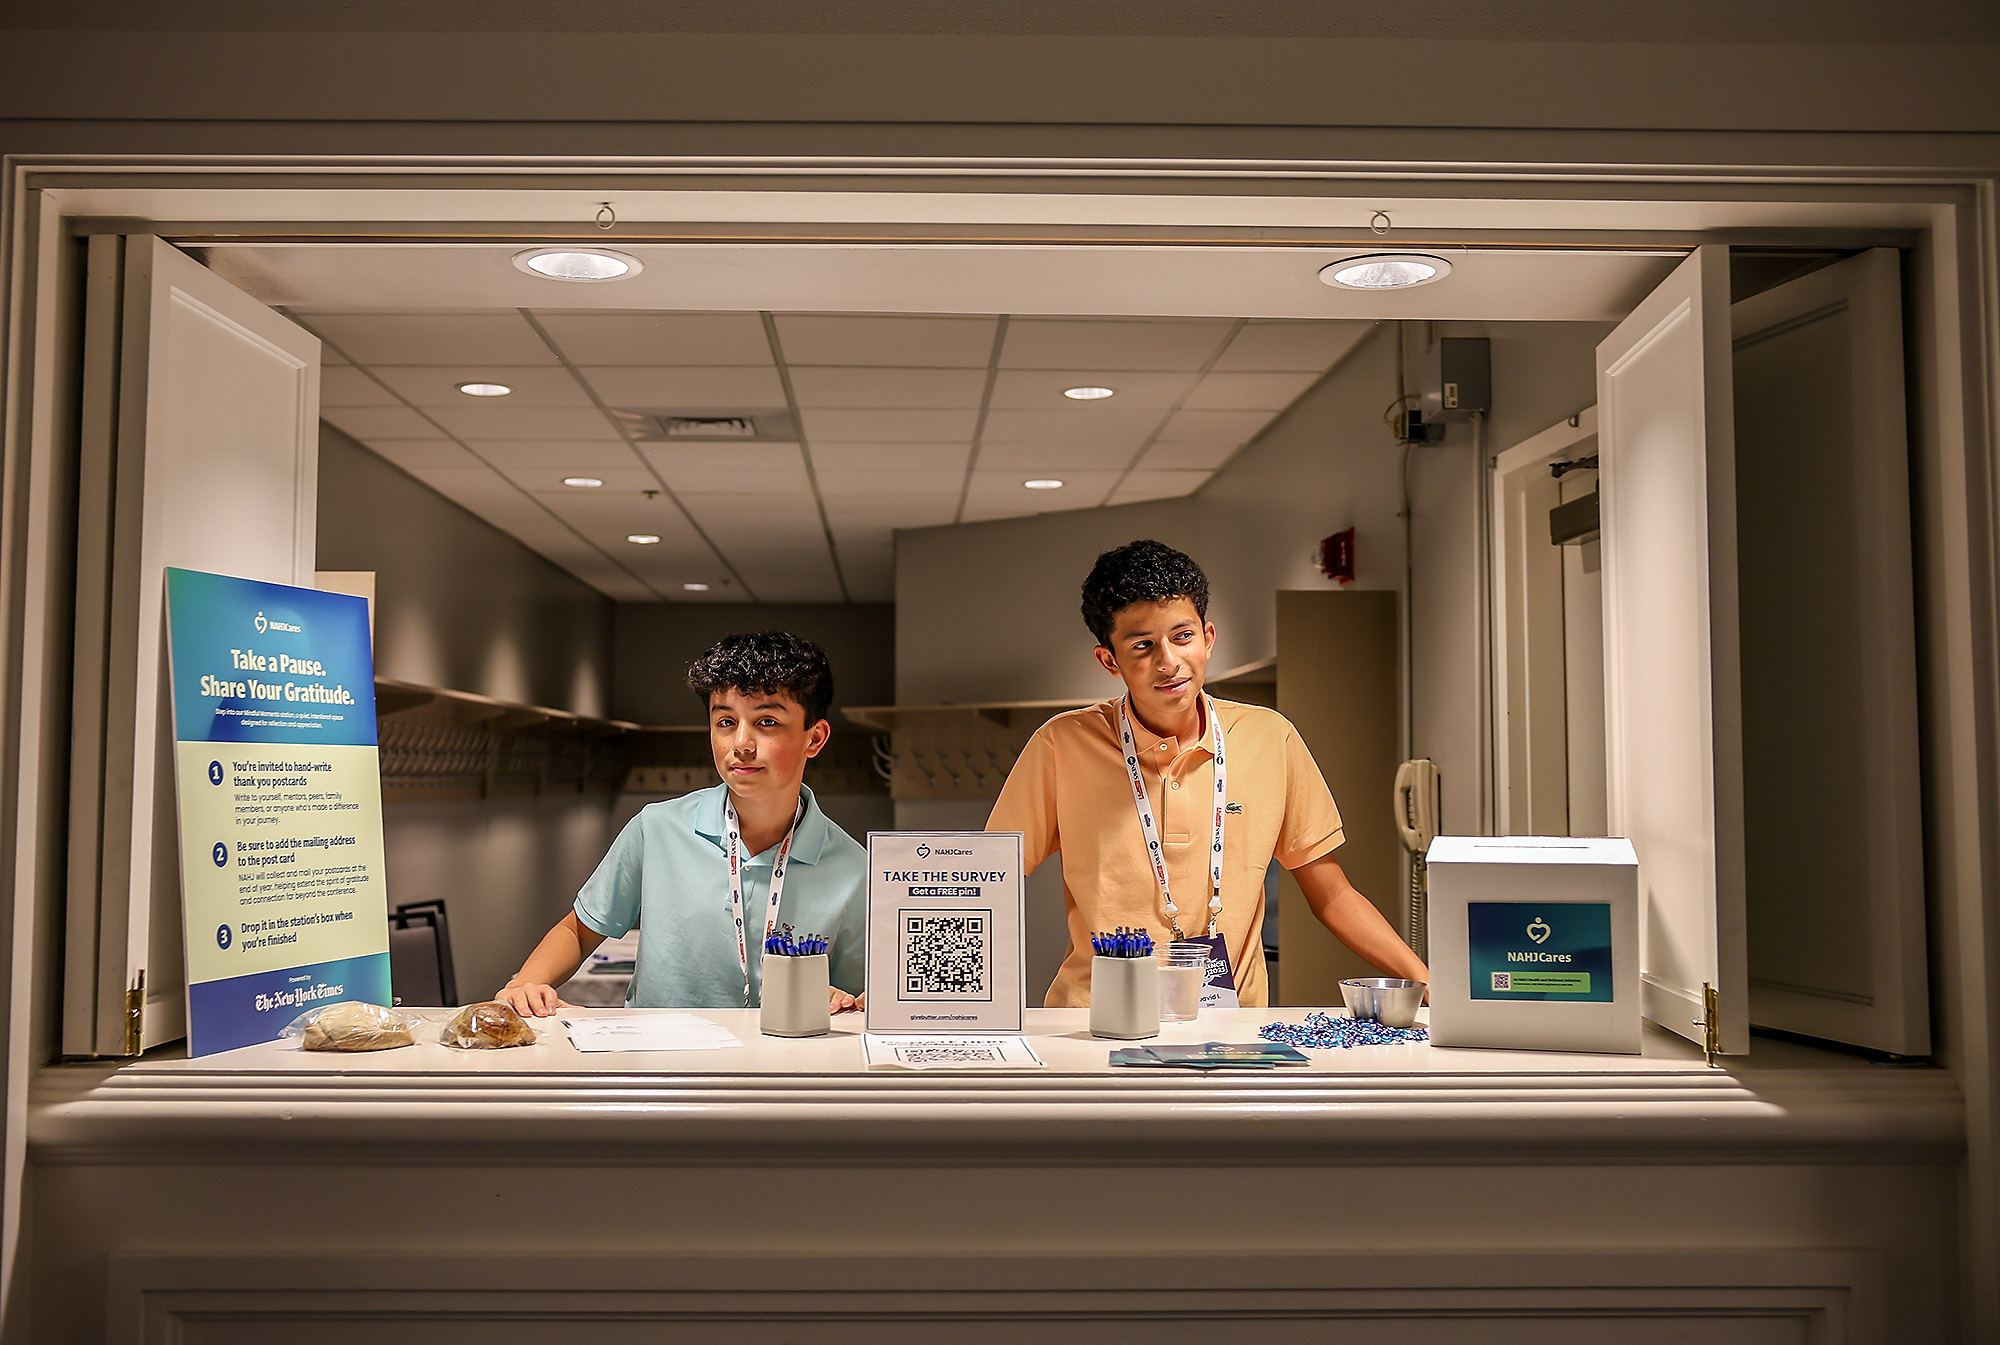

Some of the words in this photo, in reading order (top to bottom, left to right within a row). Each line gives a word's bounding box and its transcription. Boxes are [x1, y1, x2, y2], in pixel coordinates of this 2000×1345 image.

[270, 622, 301, 633] NAHJCares
[231, 648, 266, 672] Take
[269, 657, 278, 672] a
[280, 654, 326, 676] Pause.
[200, 675, 246, 698] Share
[247, 680, 282, 700] Your
[284, 682, 354, 705] Gratitude.
[241, 719, 261, 727] designed
[212, 766, 219, 780] 1
[232, 761, 256, 772] You're
[258, 762, 283, 771] invited
[285, 763, 292, 771] to
[294, 762, 332, 772] hand-write
[234, 776, 255, 786] thank
[257, 778, 270, 789] you
[272, 776, 307, 788] postcards
[259, 793, 282, 803] yourself,
[309, 794, 324, 802] peers,
[326, 792, 342, 801] family
[235, 805, 265, 813] members,
[274, 805, 294, 814] anyone
[334, 802, 359, 810] difference
[243, 818, 256, 826] your
[257, 816, 280, 826] journey.
[238, 842, 247, 851] Be
[249, 842, 264, 851] sure
[266, 841, 273, 849] to
[275, 839, 289, 849] add
[290, 838, 301, 848] the
[303, 837, 328, 849] mailing
[330, 836, 355, 845] address
[217, 848, 224, 861] 2
[238, 857, 246, 866] to
[248, 855, 260, 865] the
[262, 855, 278, 867] post
[280, 853, 295, 863] card
[267, 871, 285, 879] collect
[286, 870, 297, 878] and
[299, 868, 311, 876] mail
[312, 868, 324, 877] your
[325, 866, 350, 875] postcards
[884, 872, 918, 881] TAKE
[922, 872, 948, 881] THE
[952, 872, 1006, 881] SURVEY
[240, 885, 250, 893] end
[252, 883, 258, 892] of
[260, 883, 273, 894] year,
[275, 881, 296, 891] helping
[297, 880, 315, 888] extend
[326, 878, 338, 886] spirit
[346, 875, 369, 885] gratitude
[240, 897, 252, 905] and
[253, 894, 285, 904] connection
[295, 891, 316, 900] beyond
[327, 887, 357, 896] conference.
[959, 888, 976, 896] pin!
[242, 923, 260, 934] Drop
[262, 920, 267, 930] it
[269, 920, 276, 929] in
[277, 918, 289, 928] the
[290, 913, 319, 927] station's
[320, 912, 334, 922] box
[335, 911, 353, 921] when
[221, 930, 228, 943] 3
[242, 936, 266, 952] you're
[268, 932, 297, 945] finished
[1508, 952, 1571, 962] NAHJCares
[289, 975, 306, 983] Powered
[255, 994, 274, 1012] The
[275, 990, 295, 1008] New
[295, 985, 317, 1007] York
[317, 983, 343, 999] Times
